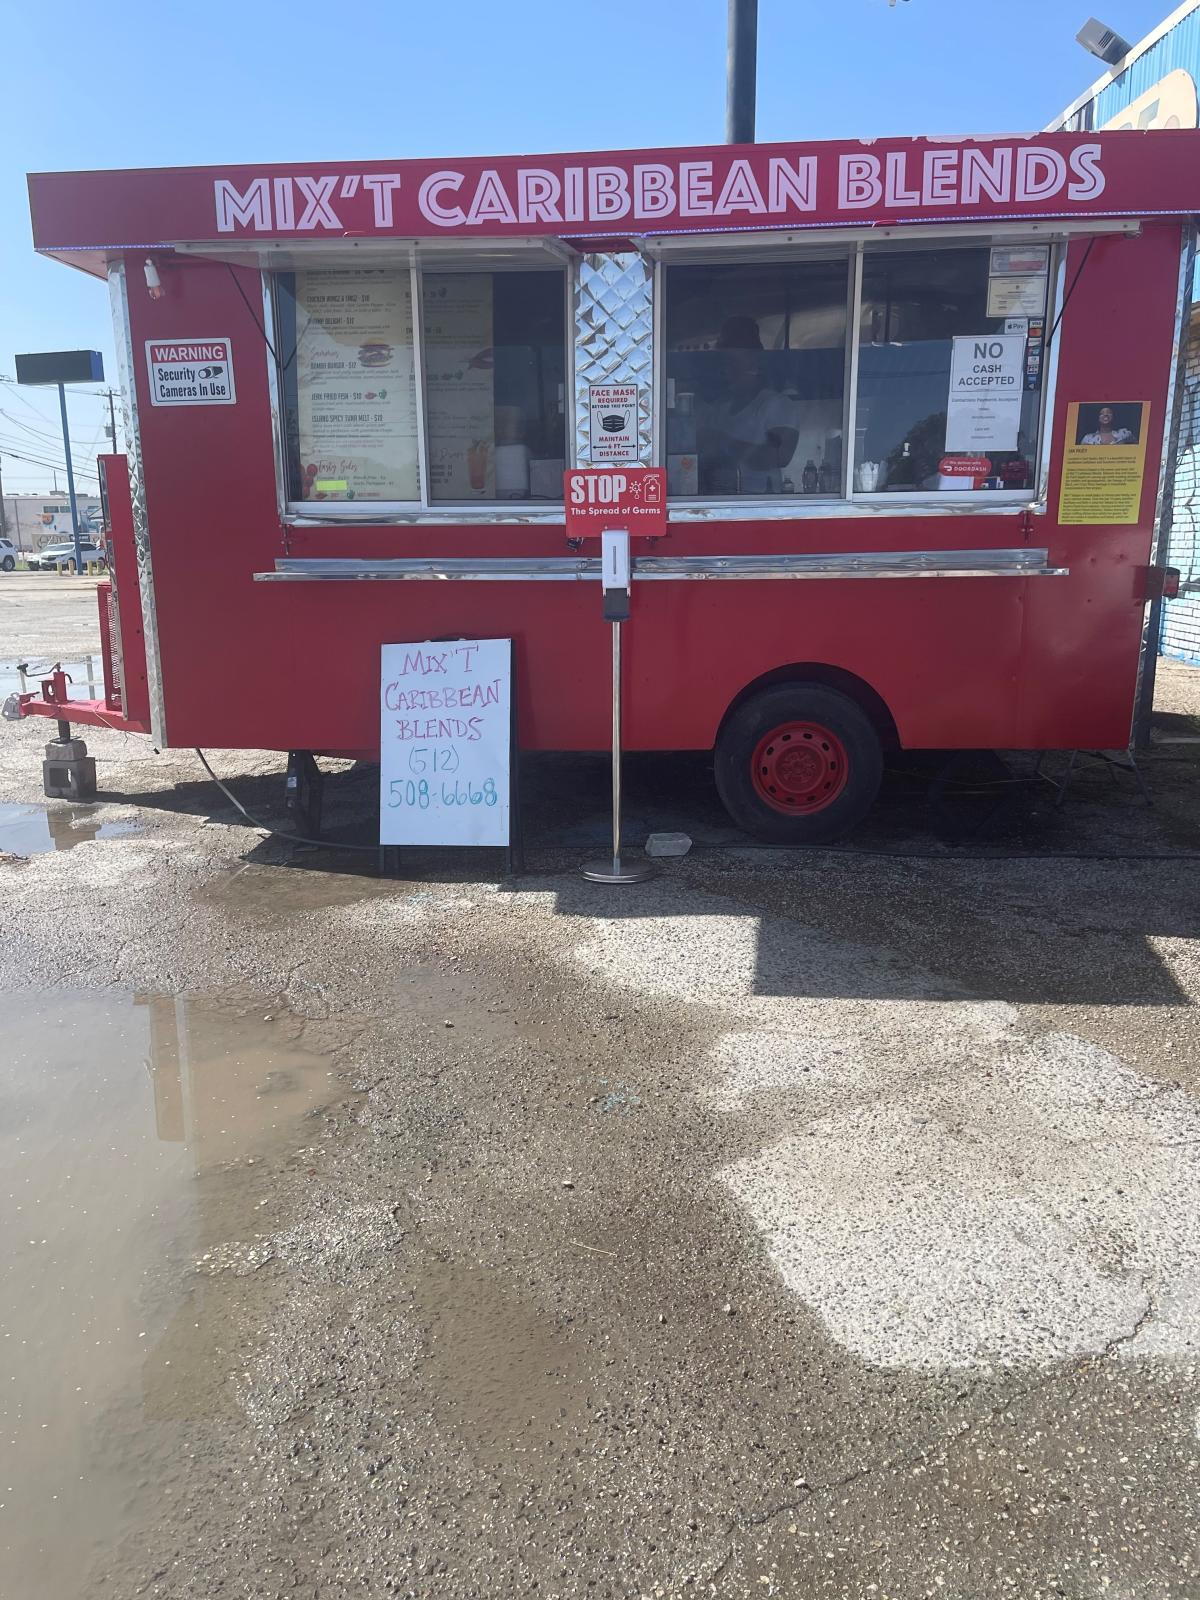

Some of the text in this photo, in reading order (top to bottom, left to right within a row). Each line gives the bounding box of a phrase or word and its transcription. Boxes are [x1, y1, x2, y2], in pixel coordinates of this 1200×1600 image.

[214, 144, 1106, 232] MIX'T CARIBBEAN BLENDS
[155, 346, 224, 361] WARNING
[974, 342, 1003, 359] NO
[158, 367, 195, 383] Security
[973, 364, 1002, 373] CASH
[958, 376, 1015, 386] ACCEPTED
[160, 383, 226, 398] Cameras In Use
[323, 392, 337, 400] FRIED
[338, 392, 349, 400] FISH
[591, 388, 636, 397] FACE MASK
[311, 415, 328, 423] ISLAND
[329, 414, 343, 423] SPICY
[345, 414, 357, 422] TUNA
[358, 414, 370, 422] MELT
[570, 474, 627, 504] STOP
[571, 506, 661, 516] The Spread of Germs
[385, 679, 501, 711] CARIBBEAN
[396, 717, 484, 741] BLENDS
[408, 744, 460, 775] (512)
[387, 777, 498, 810] 508-6668
